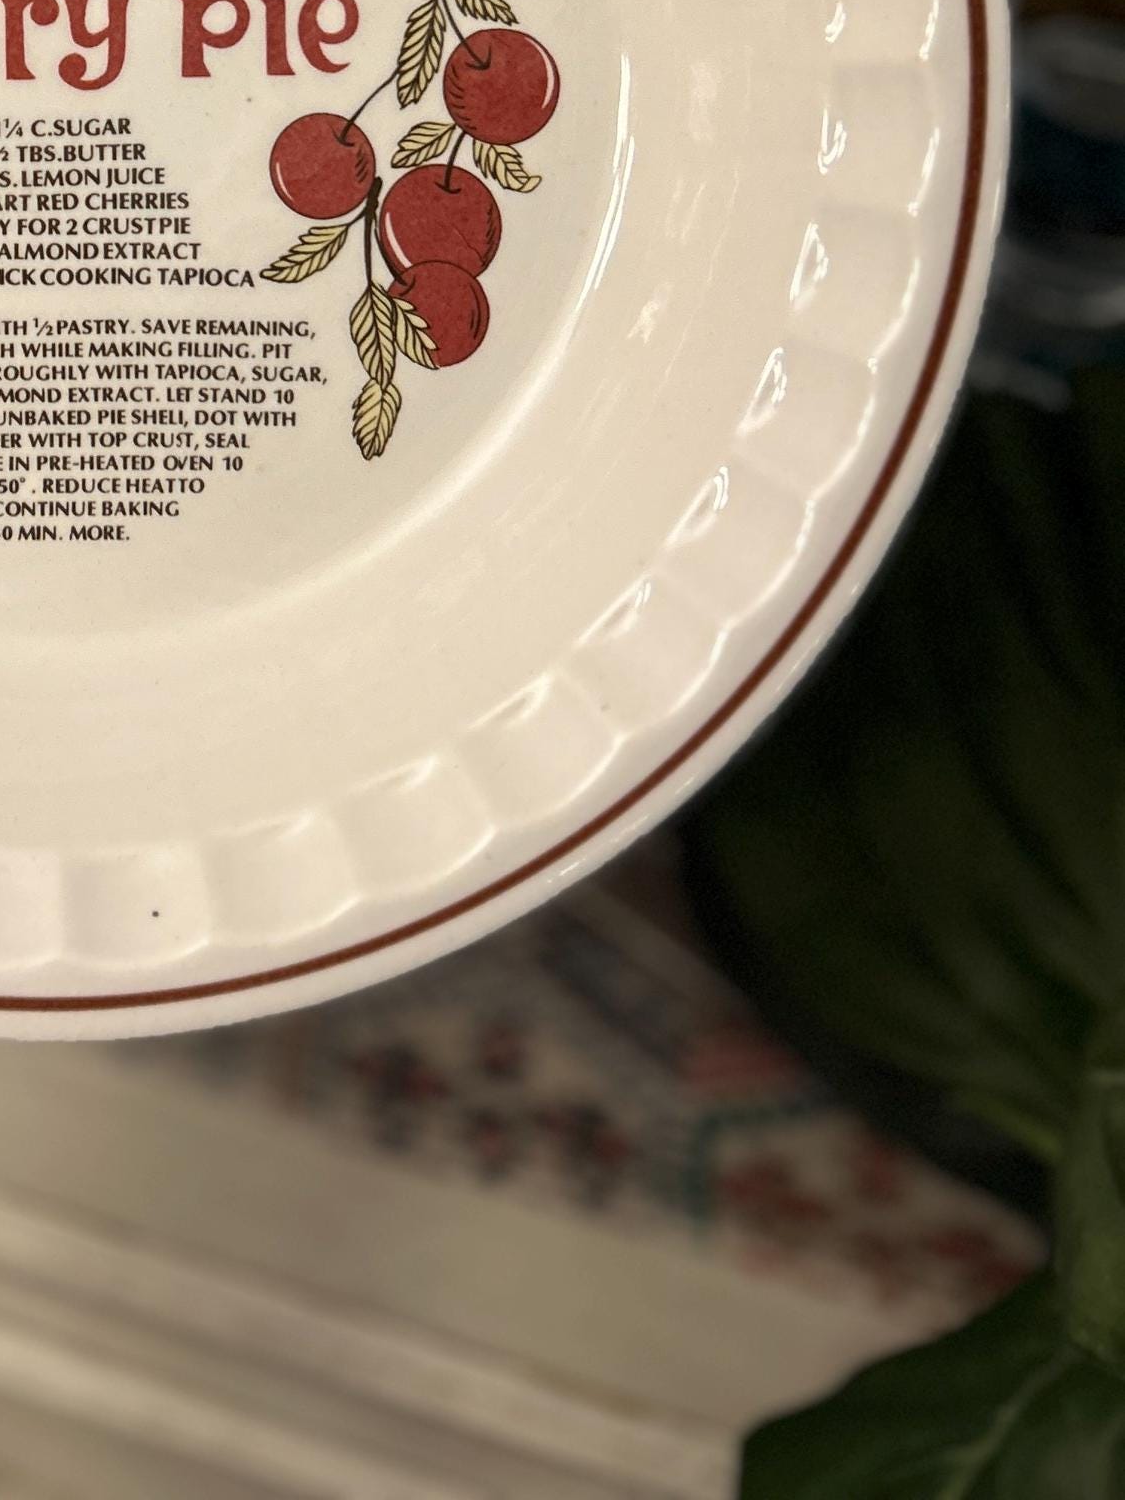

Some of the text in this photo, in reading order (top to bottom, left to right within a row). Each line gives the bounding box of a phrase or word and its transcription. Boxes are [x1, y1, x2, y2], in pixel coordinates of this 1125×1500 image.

[21, 168, 101, 188] LEMON
[106, 167, 165, 189] JUICE
[36, 192, 79, 211] RED
[84, 191, 190, 211] CHERRIES
[17, 218, 61, 236] FOR
[66, 218, 78, 236] 2
[159, 217, 191, 235] PIE
[103, 242, 202, 260] EXTRACT
[39, 267, 152, 286] COOKING
[157, 267, 255, 288] TAPIOCA
[56, 318, 136, 336] PASTRY.
[141, 318, 191, 335] SAVE
[195, 319, 316, 340] REMAINING,
[20, 342, 84, 358] WHILE
[88, 341, 173, 358] MAKING
[178, 341, 256, 359] FILLING.
[262, 343, 292, 359] PIT
[95, 364, 149, 380] WITH
[154, 364, 246, 384] TAPIOCA,
[251, 365, 328, 386] SUGAR,
[68, 386, 160, 403] EXTRACT.
[166, 387, 193, 403] LET
[198, 387, 267, 405] STAND
[273, 388, 295, 405] 10
[97, 409, 126, 425] PIE
[194, 409, 238, 426] DOT
[243, 411, 297, 427] WITH
[28, 432, 82, 448] WITH
[88, 431, 128, 448] TOP
[132, 431, 199, 451] CRUST,
[205, 432, 250, 449] SEAL
[8, 455, 30, 472] IN
[36, 454, 155, 471] PRE-HEATED
[162, 455, 214, 471] OVEN
[222, 455, 244, 472] 10
[42, 477, 121, 494] REDUCE
[101, 500, 180, 517] BAKING
[17, 525, 63, 541] MIN.
[69, 525, 130, 541] MORE.
